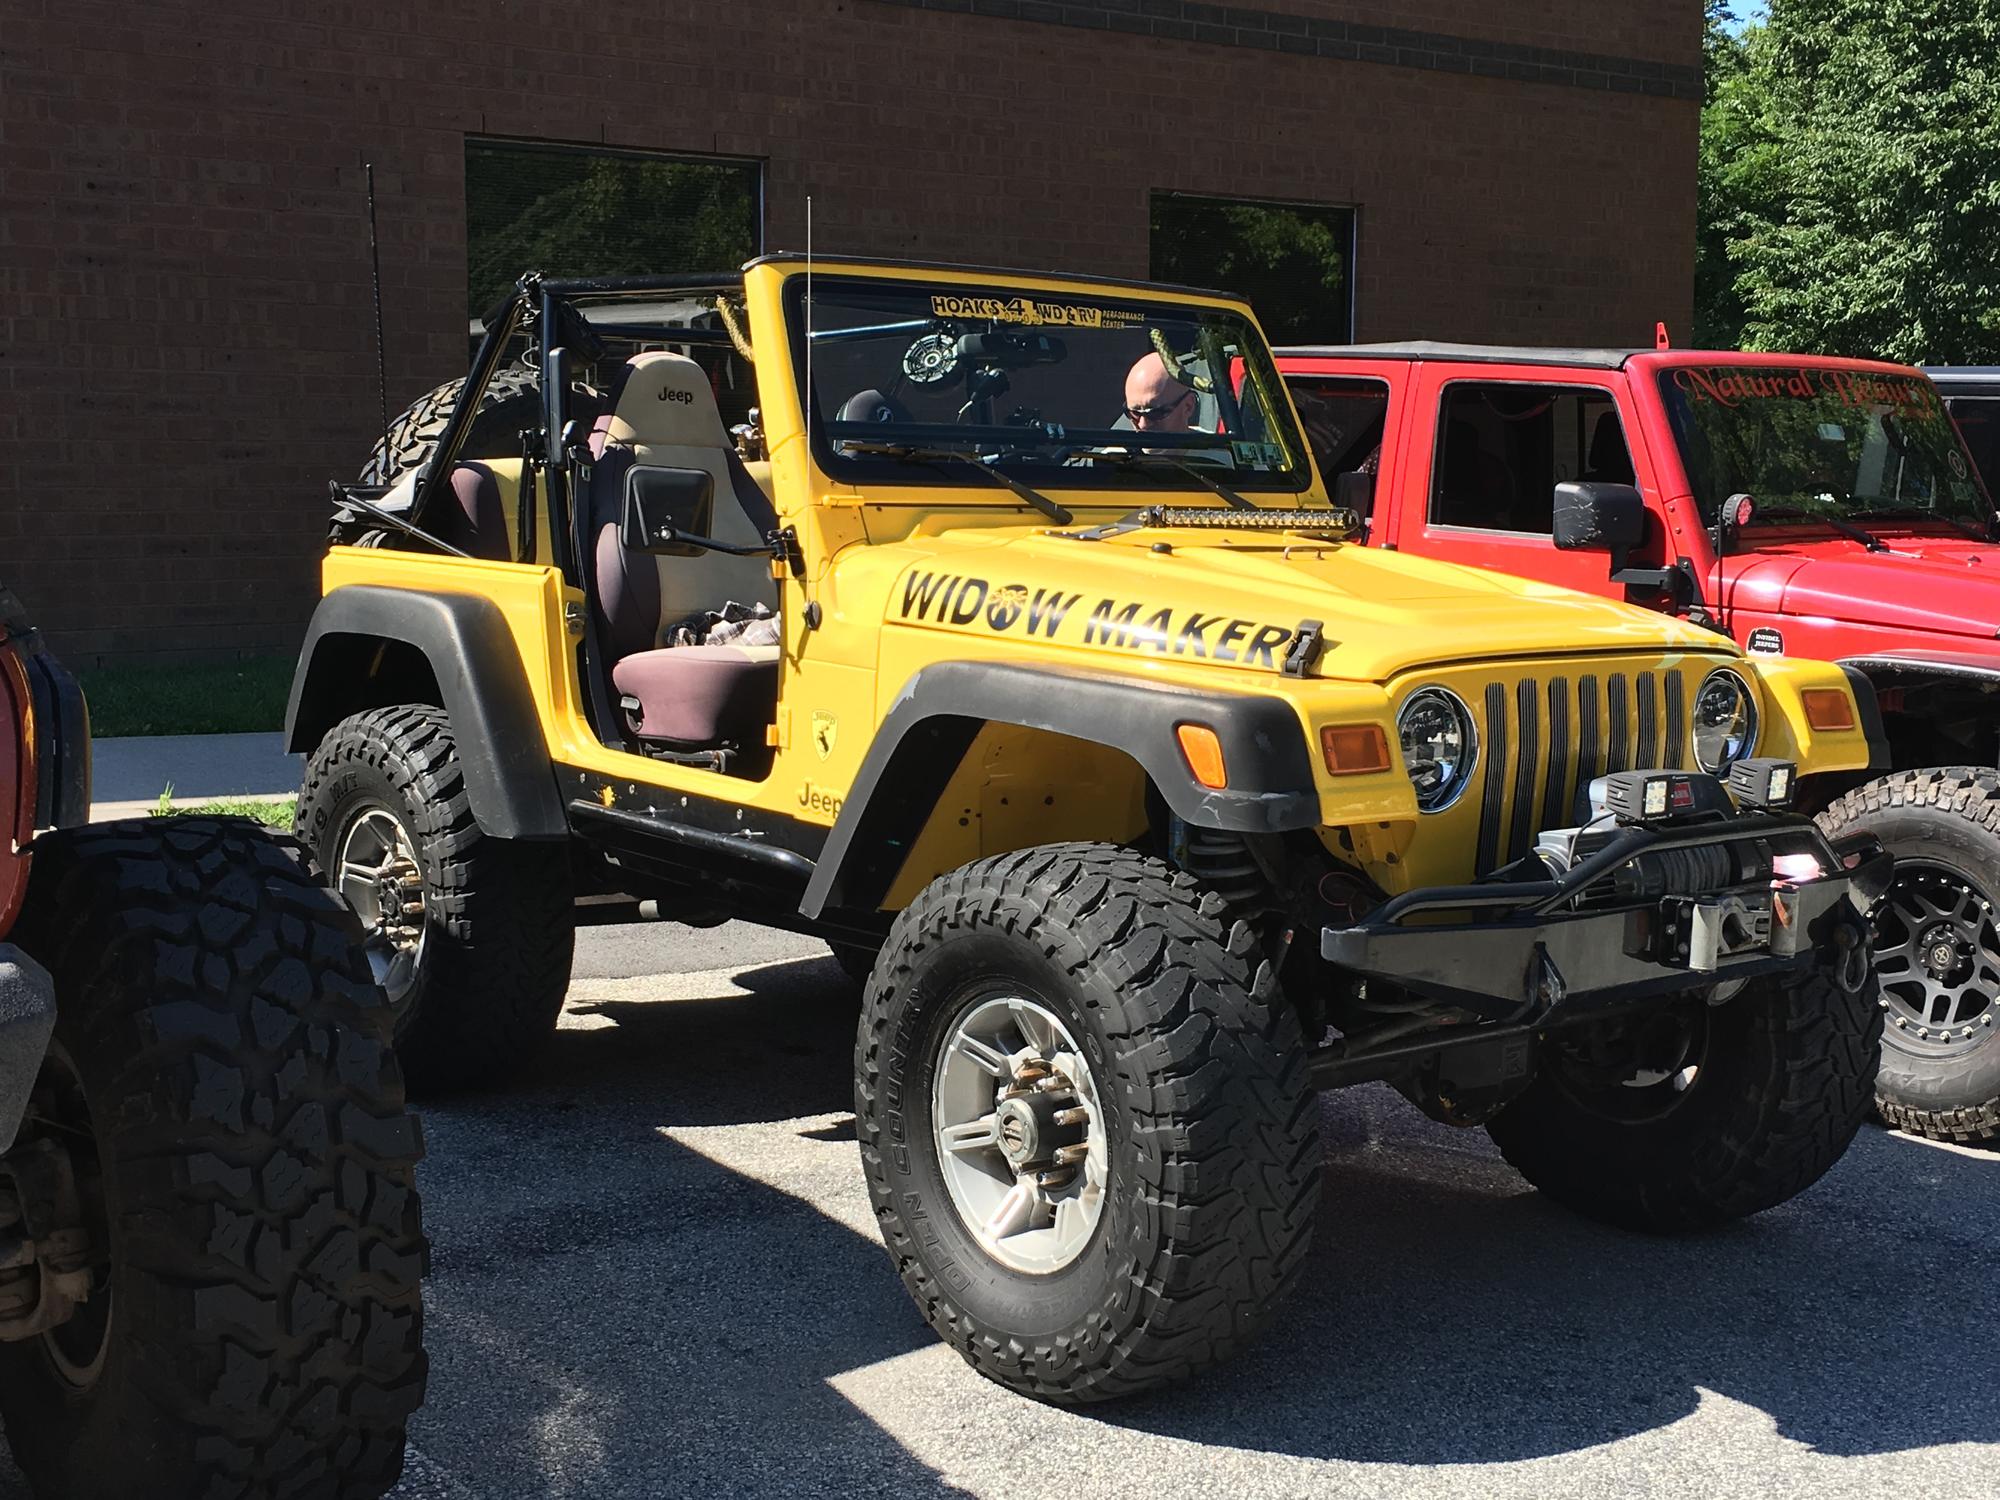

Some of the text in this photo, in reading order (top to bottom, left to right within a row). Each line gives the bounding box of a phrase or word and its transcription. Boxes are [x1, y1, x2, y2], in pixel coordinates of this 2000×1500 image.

[931, 296, 1003, 317] HOAK'S
[1066, 306, 1076, 322] &
[1078, 307, 1098, 324] RV
[1102, 310, 1145, 322] PERFORMANCE
[1102, 320, 1125, 330] CENTER
[658, 386, 693, 405] Jeep
[1673, 369, 1816, 408] Natural
[901, 570, 1293, 668] WIDOW MAKER
[813, 711, 836, 726] Jeep
[799, 782, 843, 819] Jeep
[886, 977, 974, 1293] OPEN COUNTRY
